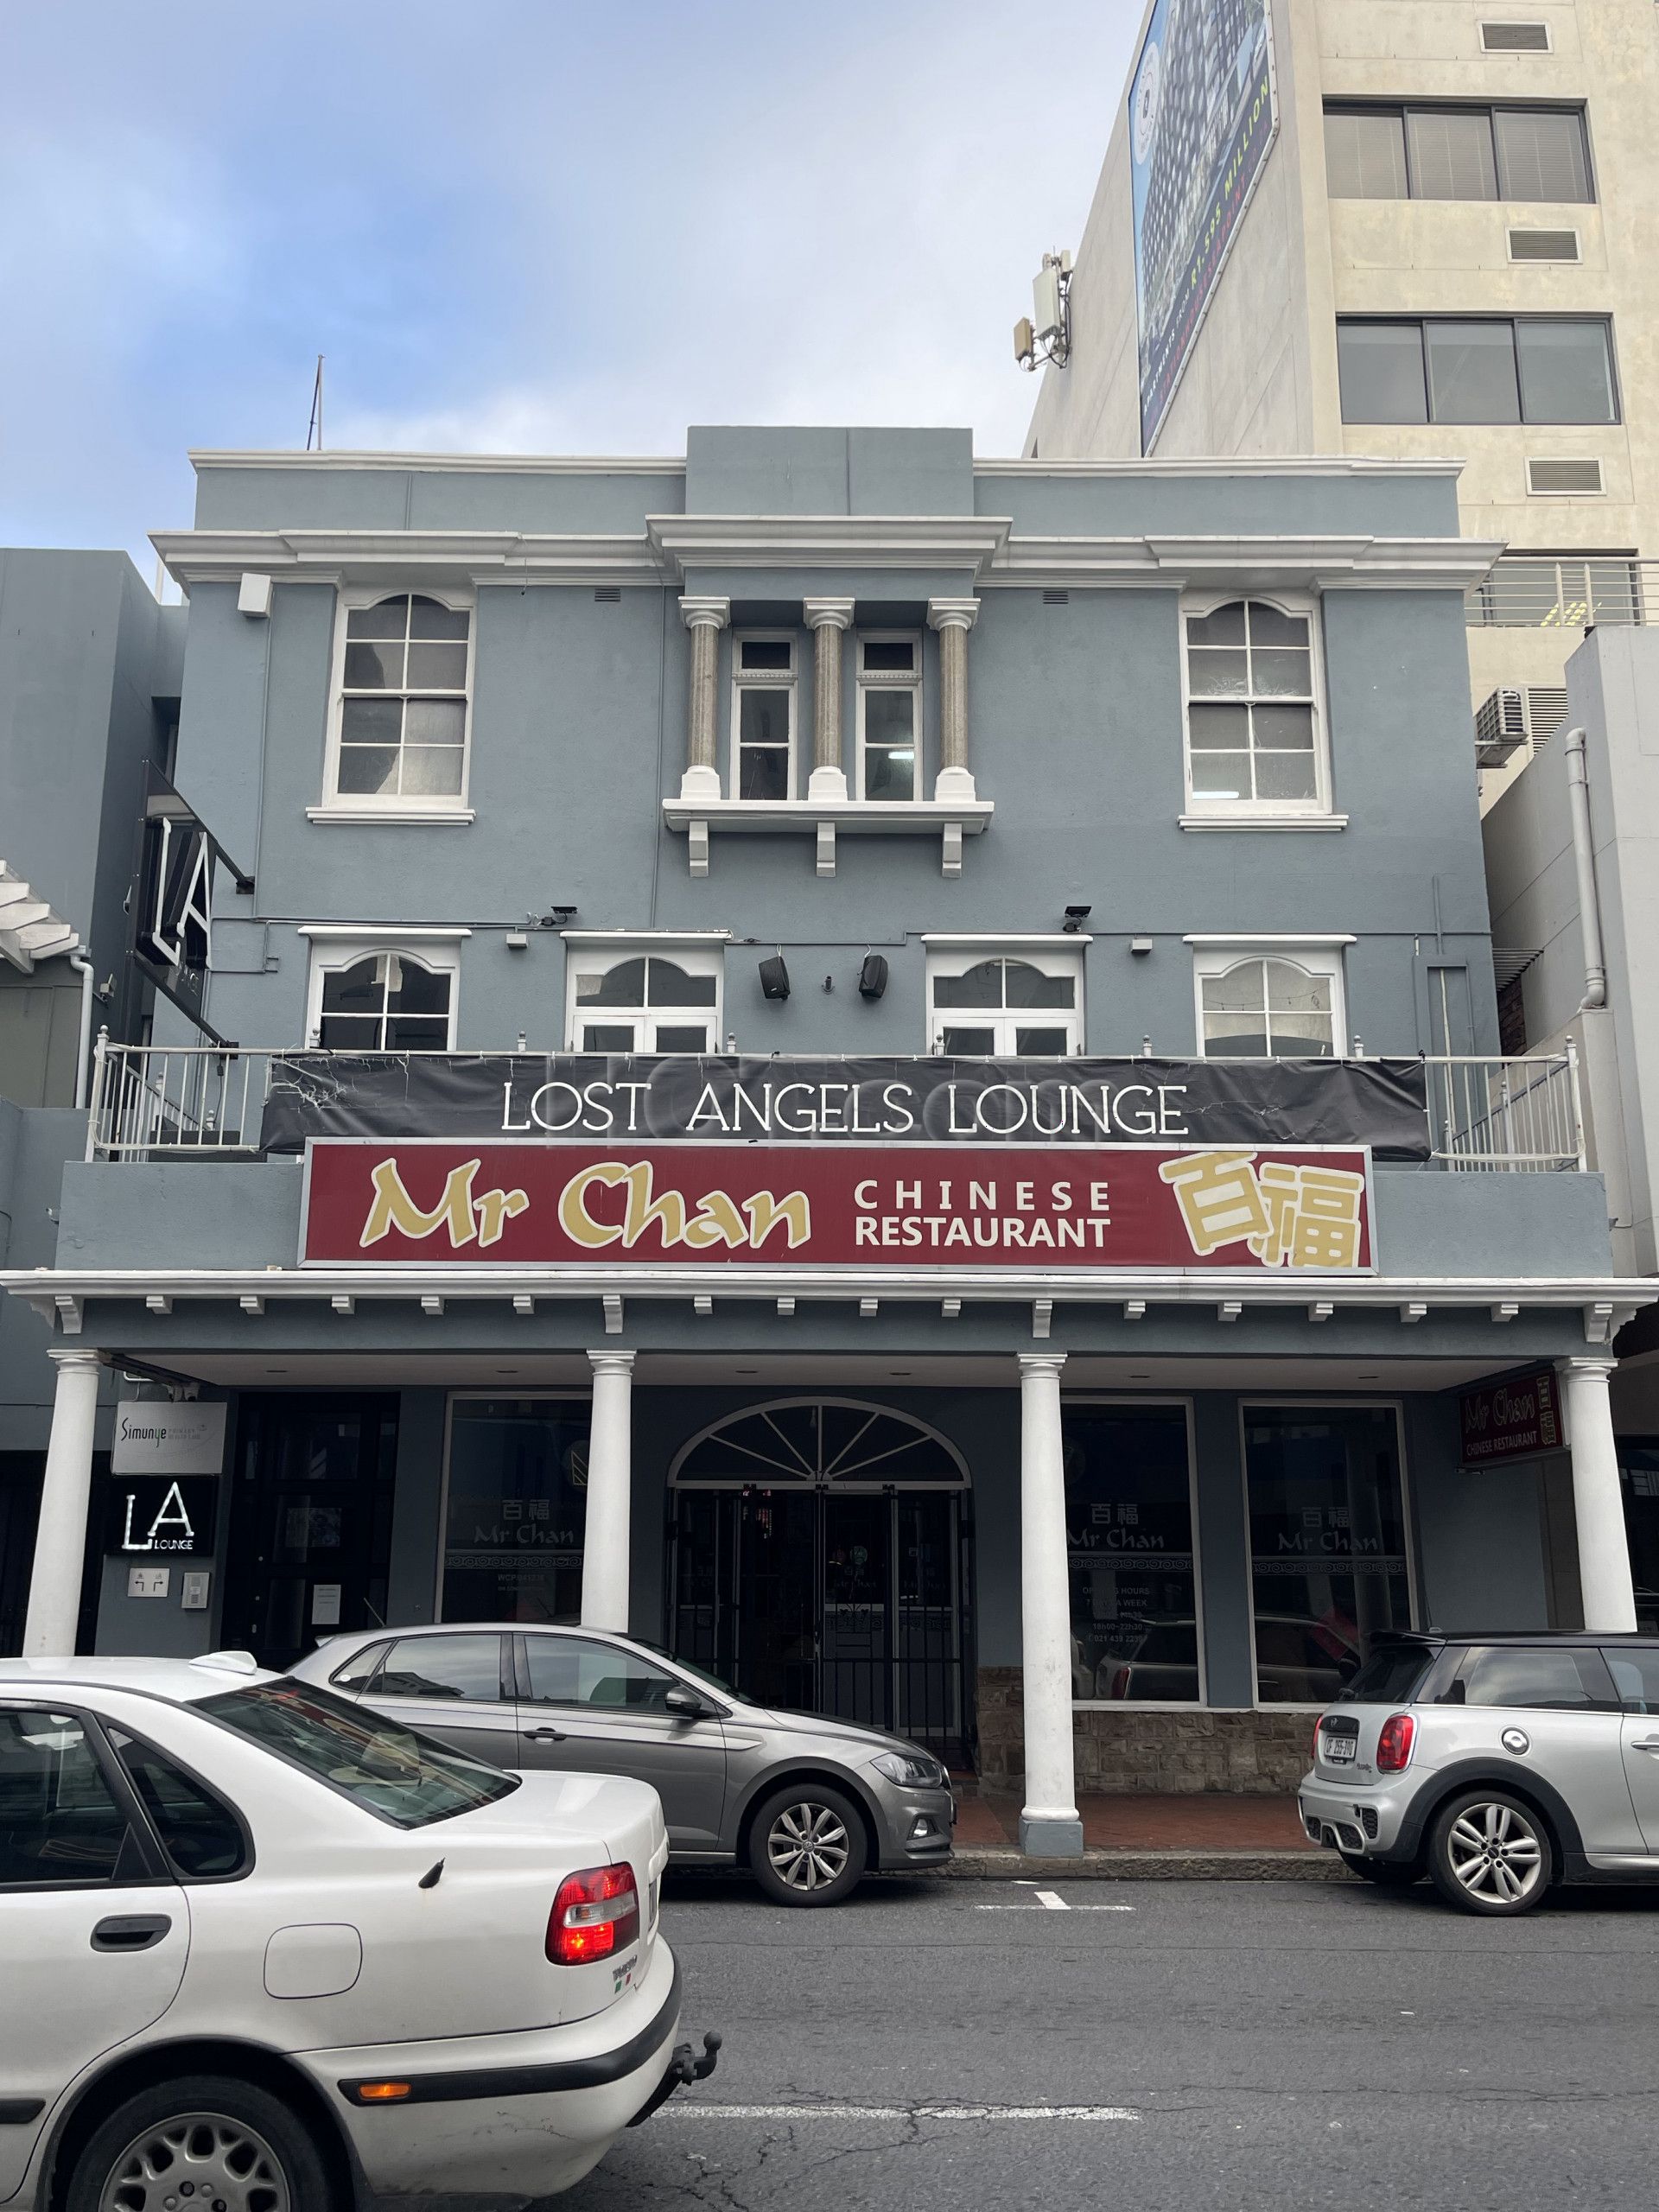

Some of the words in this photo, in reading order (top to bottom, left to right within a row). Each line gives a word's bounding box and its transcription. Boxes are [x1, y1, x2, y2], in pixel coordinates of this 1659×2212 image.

[1191, 202, 1221, 289] R1.595
[1224, 74, 1269, 201] MILLION
[502, 1081, 652, 1132] LOST
[685, 1082, 914, 1134] ANGELS
[948, 1084, 1190, 1135] LOUNGE
[359, 1157, 530, 1249] Mr
[557, 1160, 811, 1249] Chan
[854, 1179, 1111, 1211] CHINESE
[1158, 1151, 1365, 1268] 百福
[854, 1216, 1111, 1249] RESTAURANT
[1465, 1394, 1490, 1434] Mr
[1492, 1388, 1536, 1427] Chan
[121, 1417, 168, 1448] Simunye
[1465, 1440, 1494, 1457] CHINESE
[1493, 1430, 1538, 1452] RESTAURANT
[121, 1481, 195, 1550] LA
[502, 1499, 550, 1521] 百福
[1090, 1503, 1140, 1525] 百福
[1301, 1506, 1350, 1528] 百福
[154, 1540, 194, 1550] LOUNGE
[473, 1524, 511, 1544] Mr
[516, 1523, 575, 1545] Chan
[1067, 1529, 1101, 1548] Mr
[1106, 1528, 1166, 1549] Chan
[1278, 1531, 1313, 1551] Mr
[1319, 1530, 1378, 1552] Chan
[1121, 1586, 1150, 1595] HOURS
[1123, 1599, 1148, 1607] WEEK
